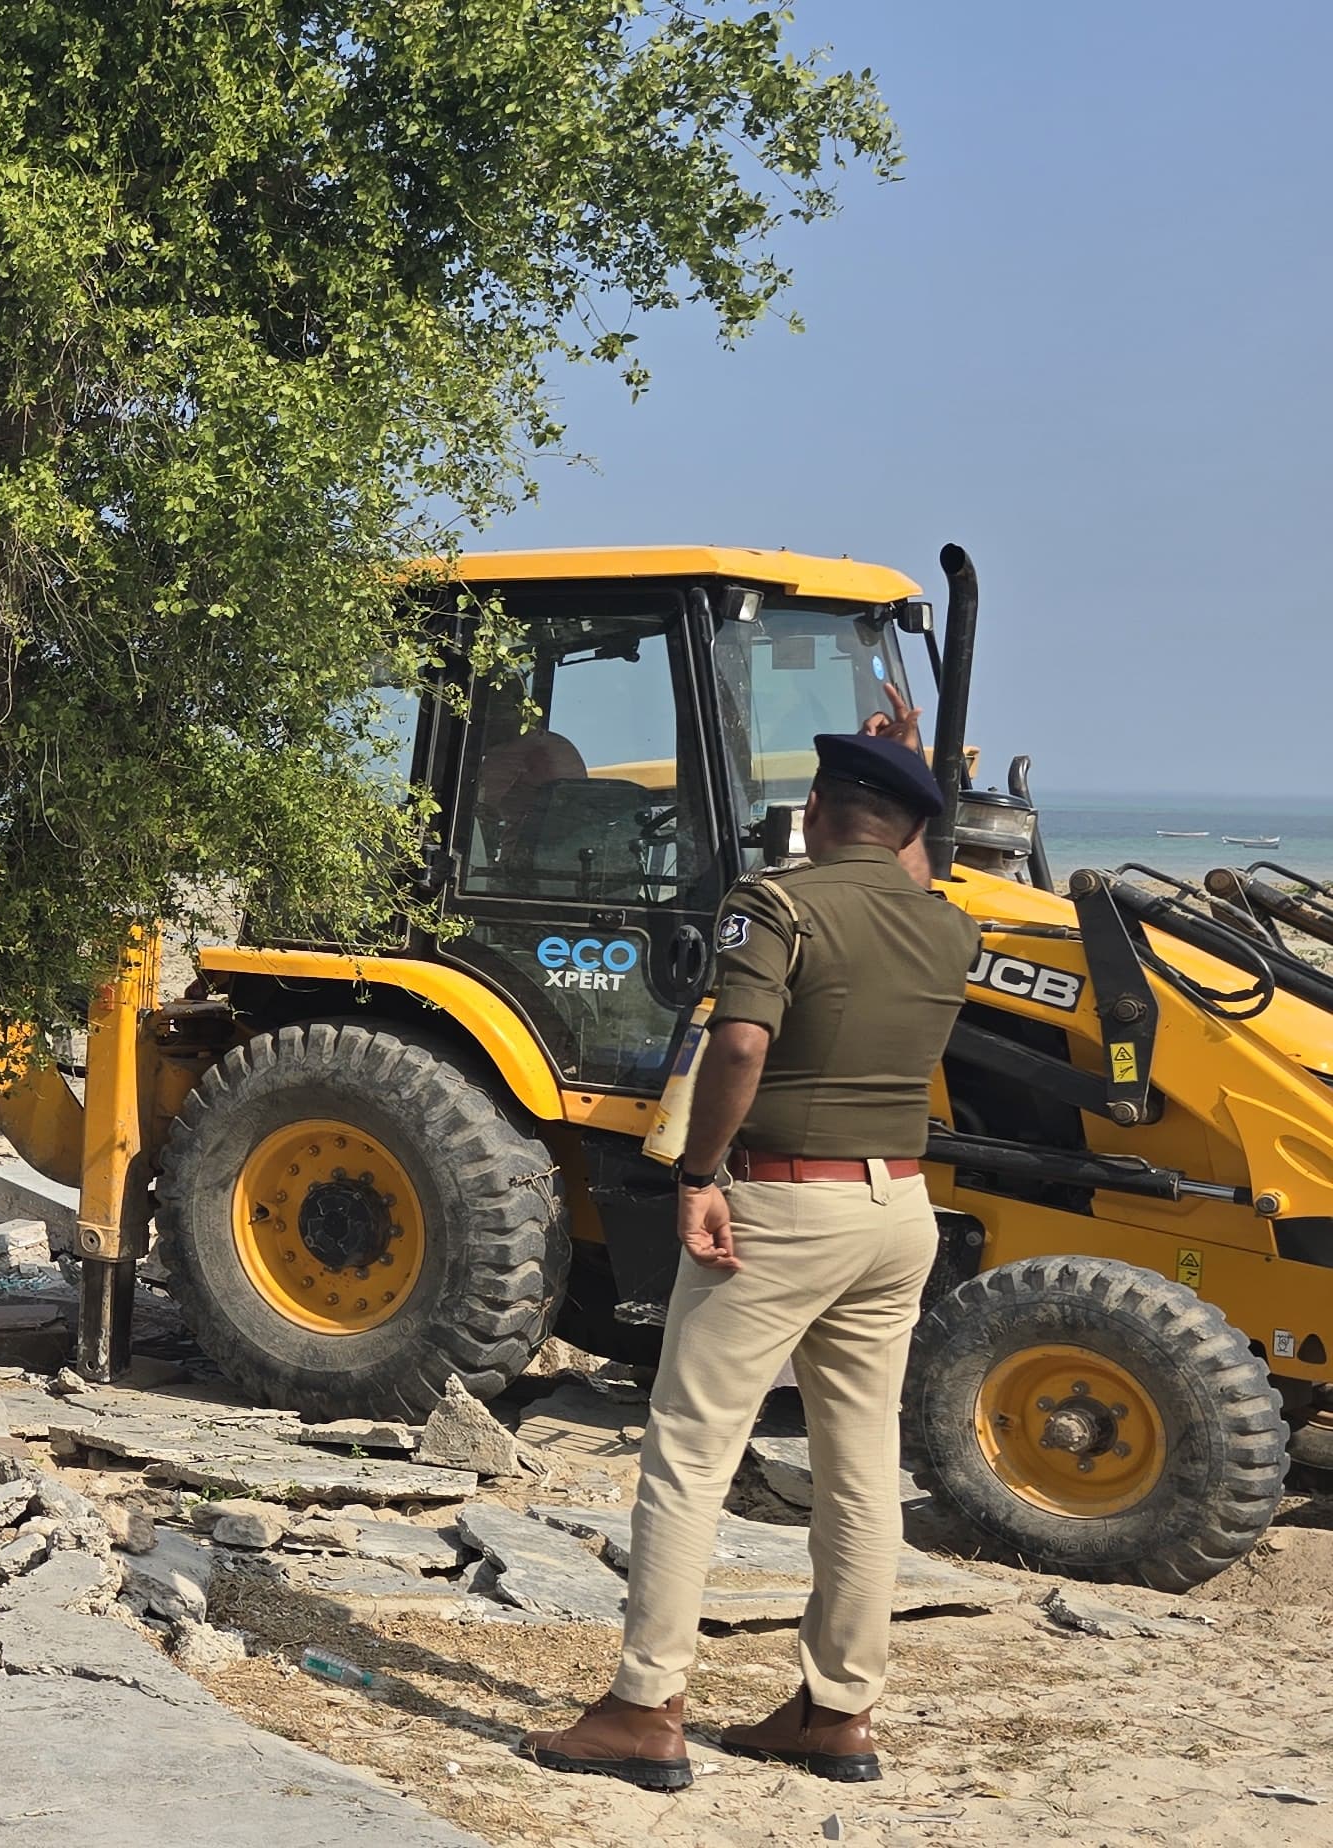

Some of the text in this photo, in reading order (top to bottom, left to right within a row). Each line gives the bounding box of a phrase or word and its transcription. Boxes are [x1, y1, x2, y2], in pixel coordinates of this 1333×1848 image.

[537, 936, 637, 972] eco
[544, 969, 625, 991] XPERT
[966, 951, 1079, 1007] JCB
